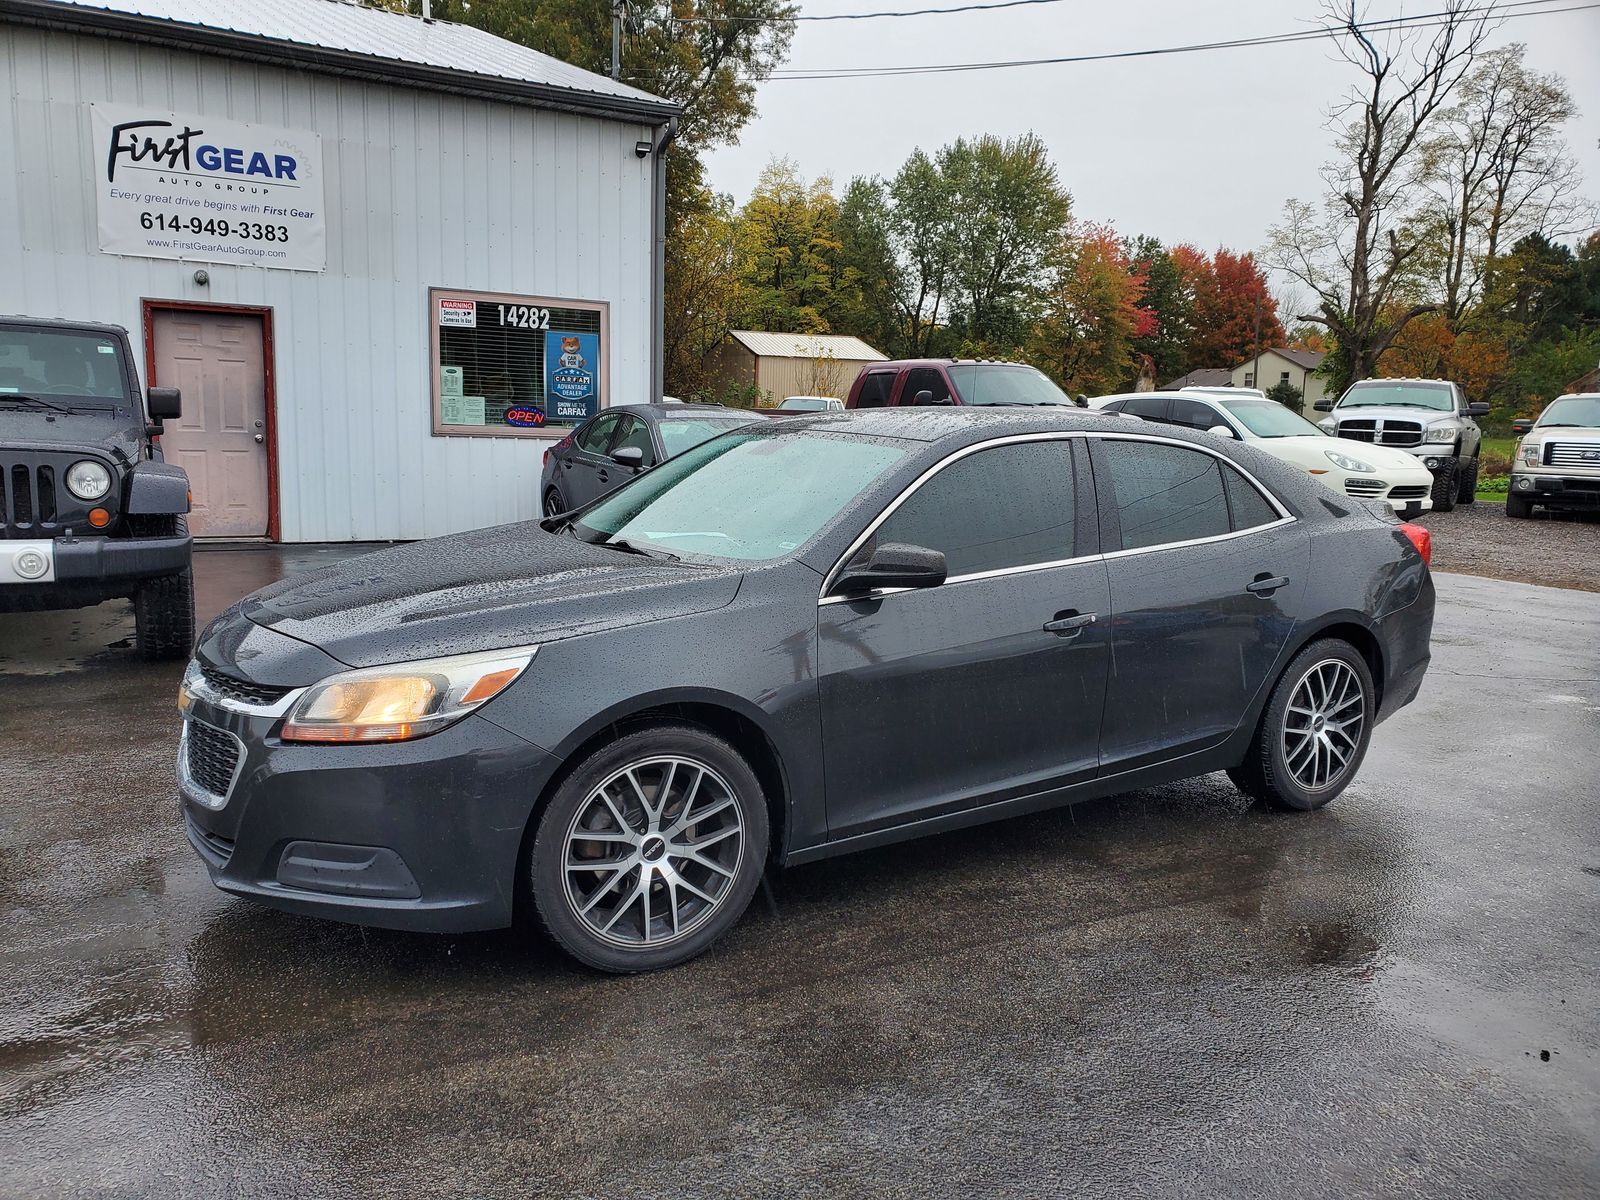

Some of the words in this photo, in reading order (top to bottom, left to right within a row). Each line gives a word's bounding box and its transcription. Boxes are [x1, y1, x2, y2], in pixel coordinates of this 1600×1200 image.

[108, 120, 204, 183] First
[196, 144, 298, 181] GEAR
[158, 176, 203, 188] AUTO
[214, 183, 270, 196] GROUP
[110, 188, 142, 201] Every
[144, 193, 172, 205] great
[175, 195, 201, 208] drive
[203, 199, 238, 213] begins
[240, 203, 260, 214] with
[263, 205, 287, 217] First
[290, 208, 315, 219] Gear
[140, 211, 289, 243] 614-949-3383
[146, 238, 287, 258] www.FirstGearAutoGroup.com
[442, 301, 473, 310] WARNING
[443, 309, 460, 317] Security
[497, 304, 550, 330] 14282
[555, 376, 590, 384] CARFAX
[557, 383, 588, 391] ADVANTAGE
[507, 410, 545, 423] OPEN
[557, 407, 587, 416] CARFAX
